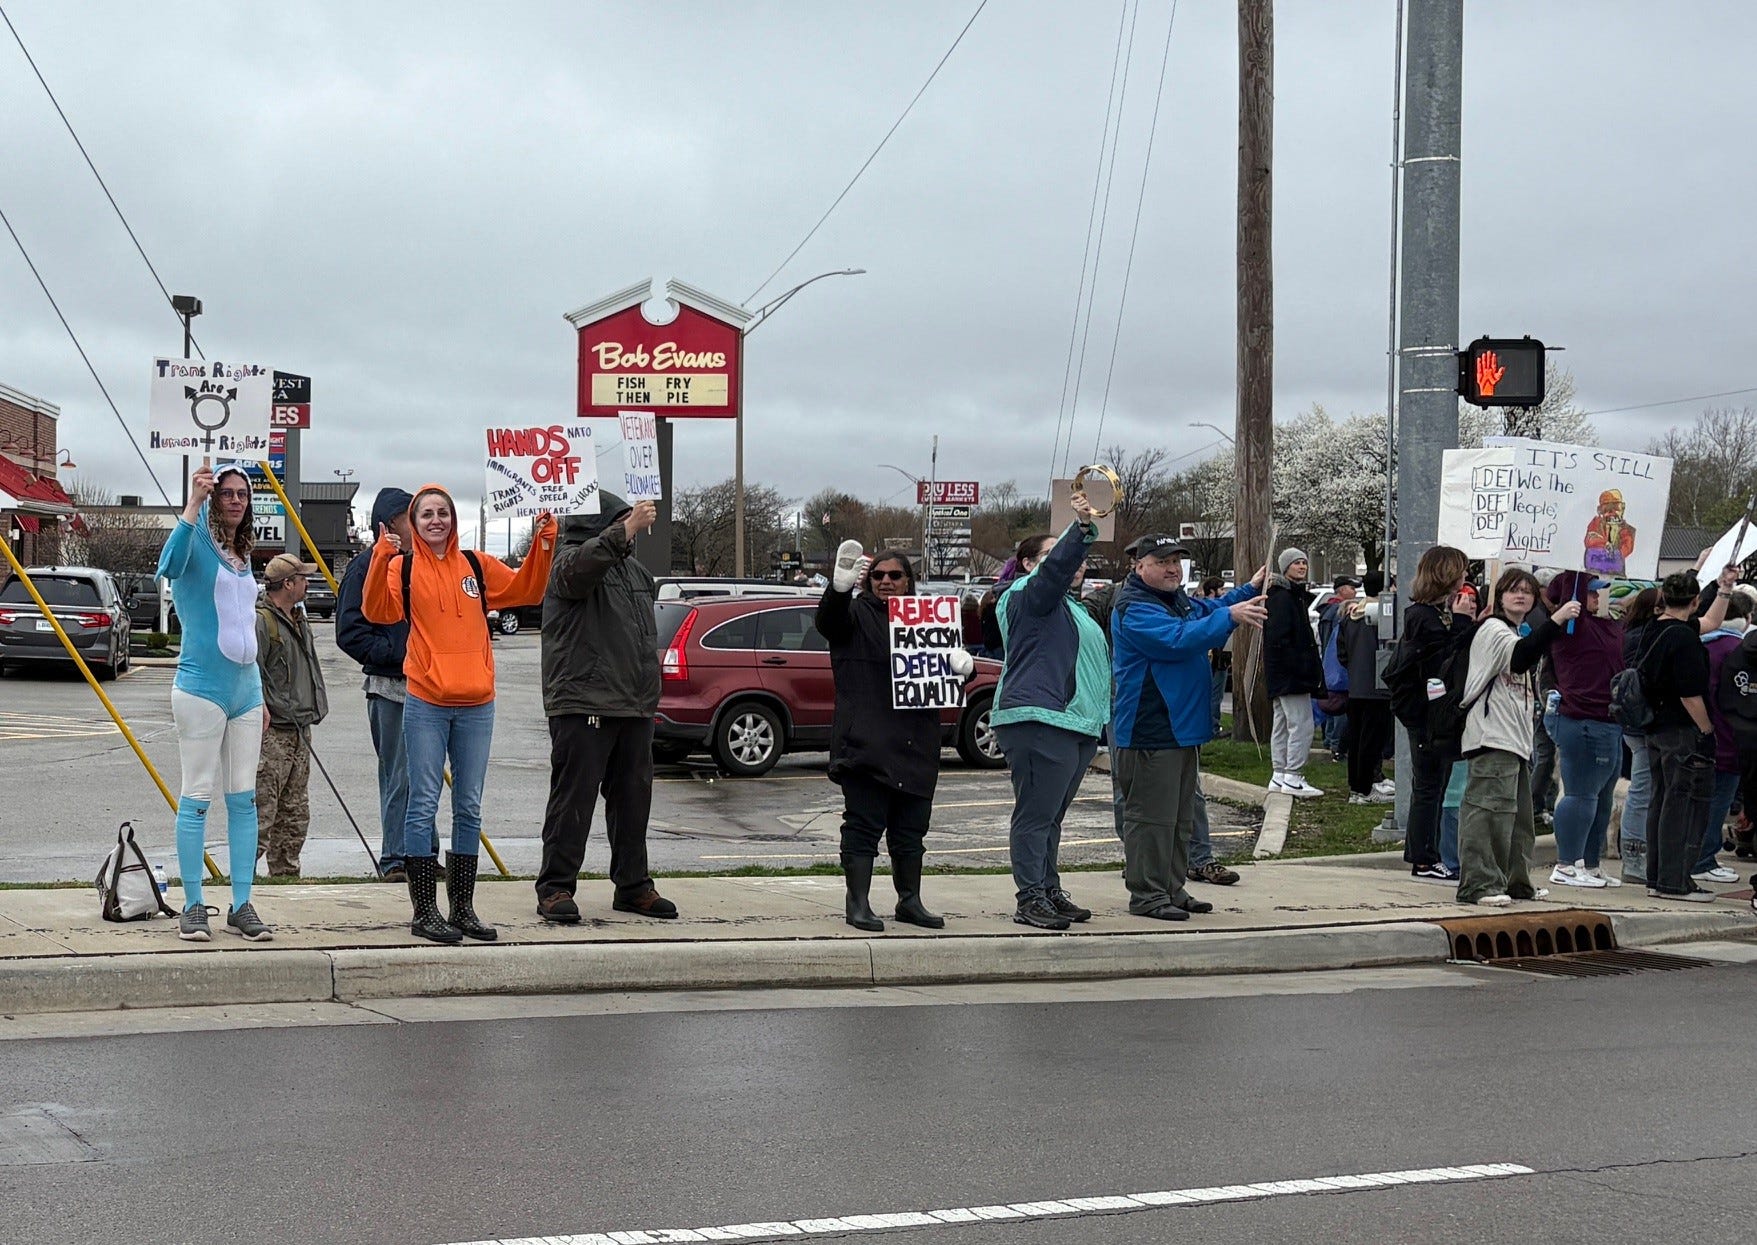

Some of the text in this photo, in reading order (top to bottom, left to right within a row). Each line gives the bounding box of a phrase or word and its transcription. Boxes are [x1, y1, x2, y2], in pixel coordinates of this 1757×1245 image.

[592, 342, 726, 371] Bob Evans
[156, 360, 266, 382] Trans Rights
[200, 380, 224, 393] Are
[617, 377, 691, 389] FISH FRY
[616, 392, 689, 403] THEN PIE
[271, 406, 299, 425] ES
[150, 431, 267, 453] Human Rights
[487, 425, 570, 457] HANDS
[567, 427, 592, 438] NATO
[630, 445, 652, 468] OVER
[1526, 448, 1654, 480] IT'S STILL
[487, 459, 537, 496] IMMIGRANTS
[531, 457, 582, 485] OFF
[489, 484, 521, 502] TRANS
[541, 485, 564, 493] FREE
[569, 479, 599, 510] SCHOOLS
[947, 483, 975, 496] LESS
[1549, 473, 1574, 494] The
[493, 493, 524, 513] RIGHTS
[254, 526, 283, 541] VEL
[1507, 522, 1558, 561] Right?
[889, 597, 958, 625] REJECT
[894, 627, 961, 649] FASCISM
[894, 677, 965, 708] EQUALITY
